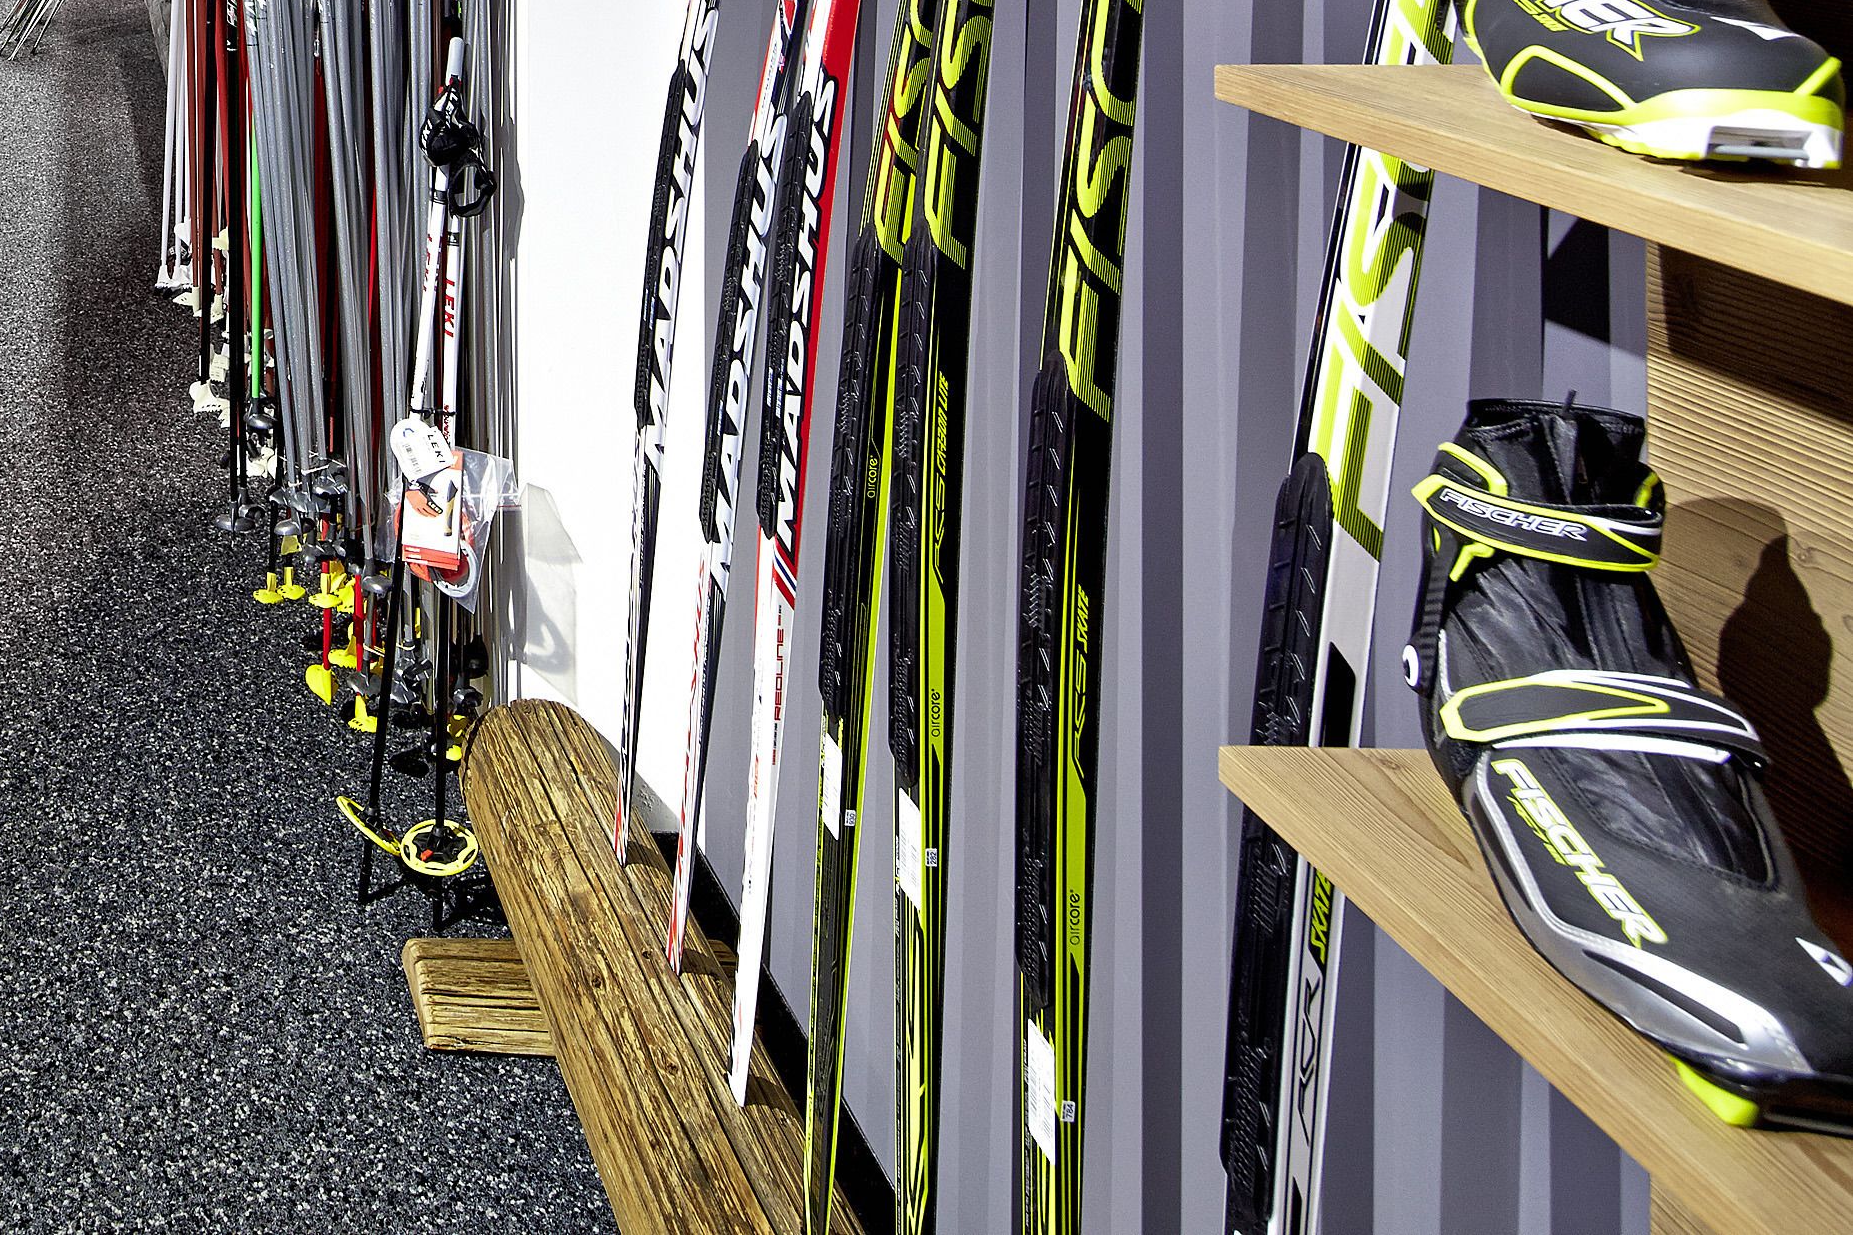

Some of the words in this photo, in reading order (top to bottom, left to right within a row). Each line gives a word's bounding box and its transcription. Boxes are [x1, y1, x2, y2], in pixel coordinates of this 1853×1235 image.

[644, 6, 720, 483] MADSHUS
[444, 278, 455, 338] LEKI
[774, 71, 838, 556] MADSHUS
[710, 113, 787, 601] MADSHUS
[938, 372, 949, 409] LITE
[427, 433, 446, 464] LEKI
[936, 410, 948, 476] CARBON
[867, 455, 878, 499] aircore
[1441, 487, 1589, 542] FISCHER
[1075, 584, 1089, 653] SKATE
[774, 628, 785, 721] REDLINE
[931, 687, 942, 739] aircore
[1491, 758, 1669, 950] FISCHER
[1068, 888, 1080, 946] aircore
